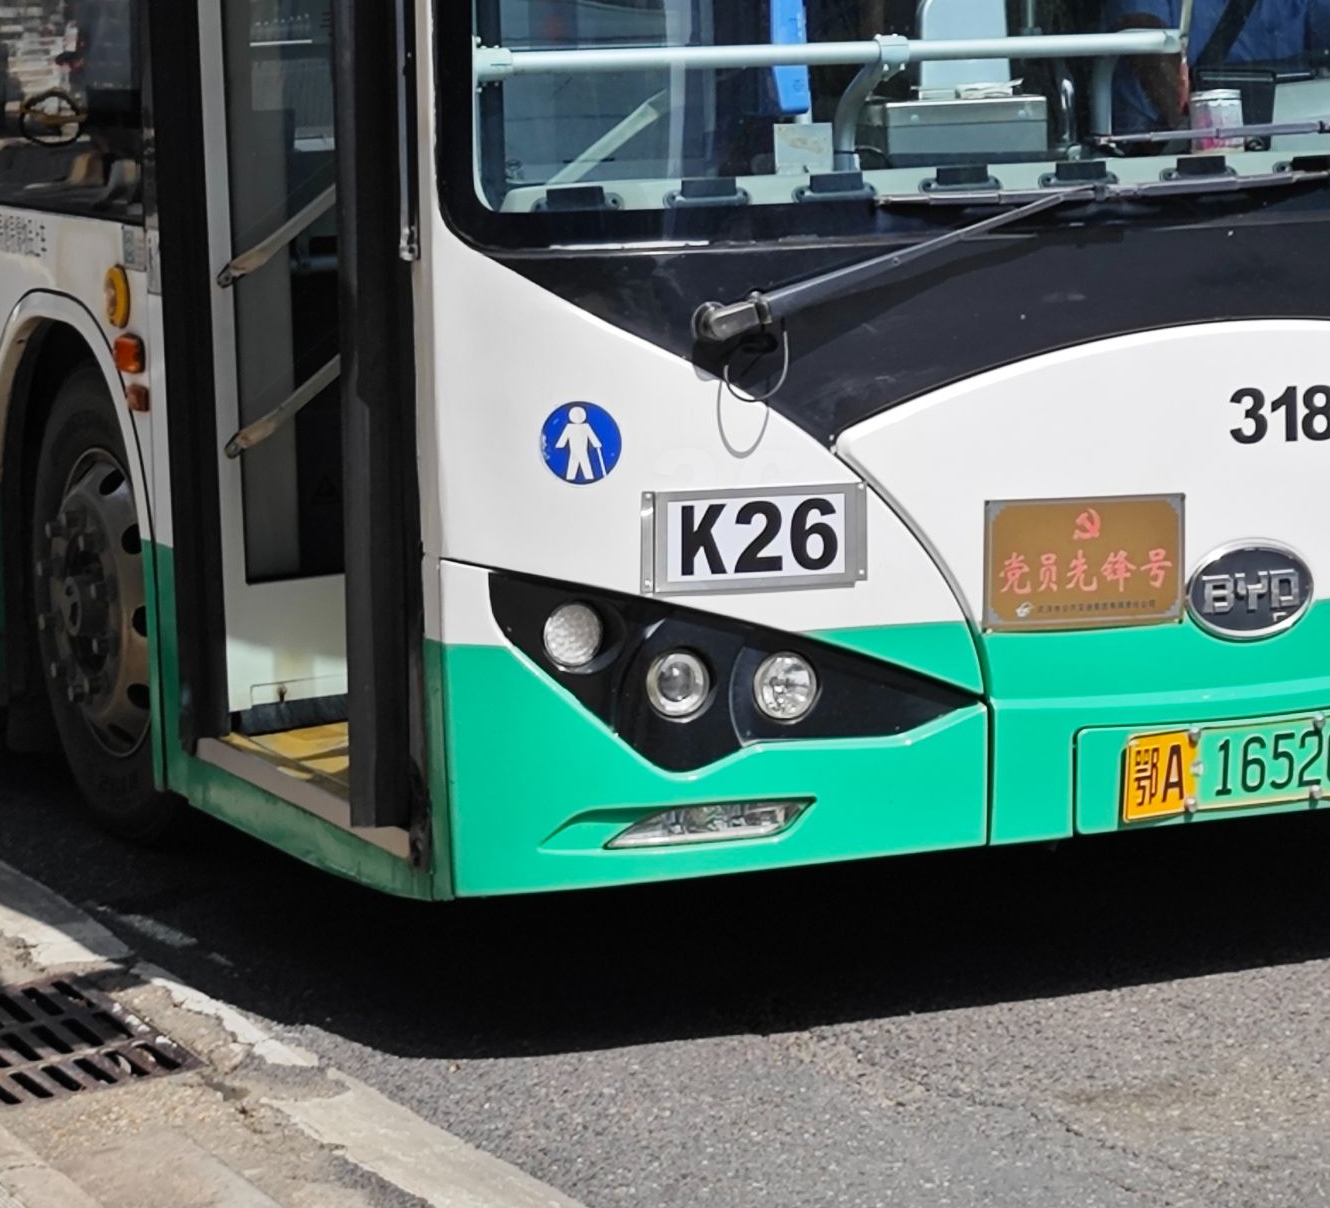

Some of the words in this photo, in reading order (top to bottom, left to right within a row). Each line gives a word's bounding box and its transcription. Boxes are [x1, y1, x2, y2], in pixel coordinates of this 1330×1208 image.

[680, 497, 839, 576] K26
[998, 548, 1174, 595] 党员先锋号
[1201, 567, 1300, 615] BYD
